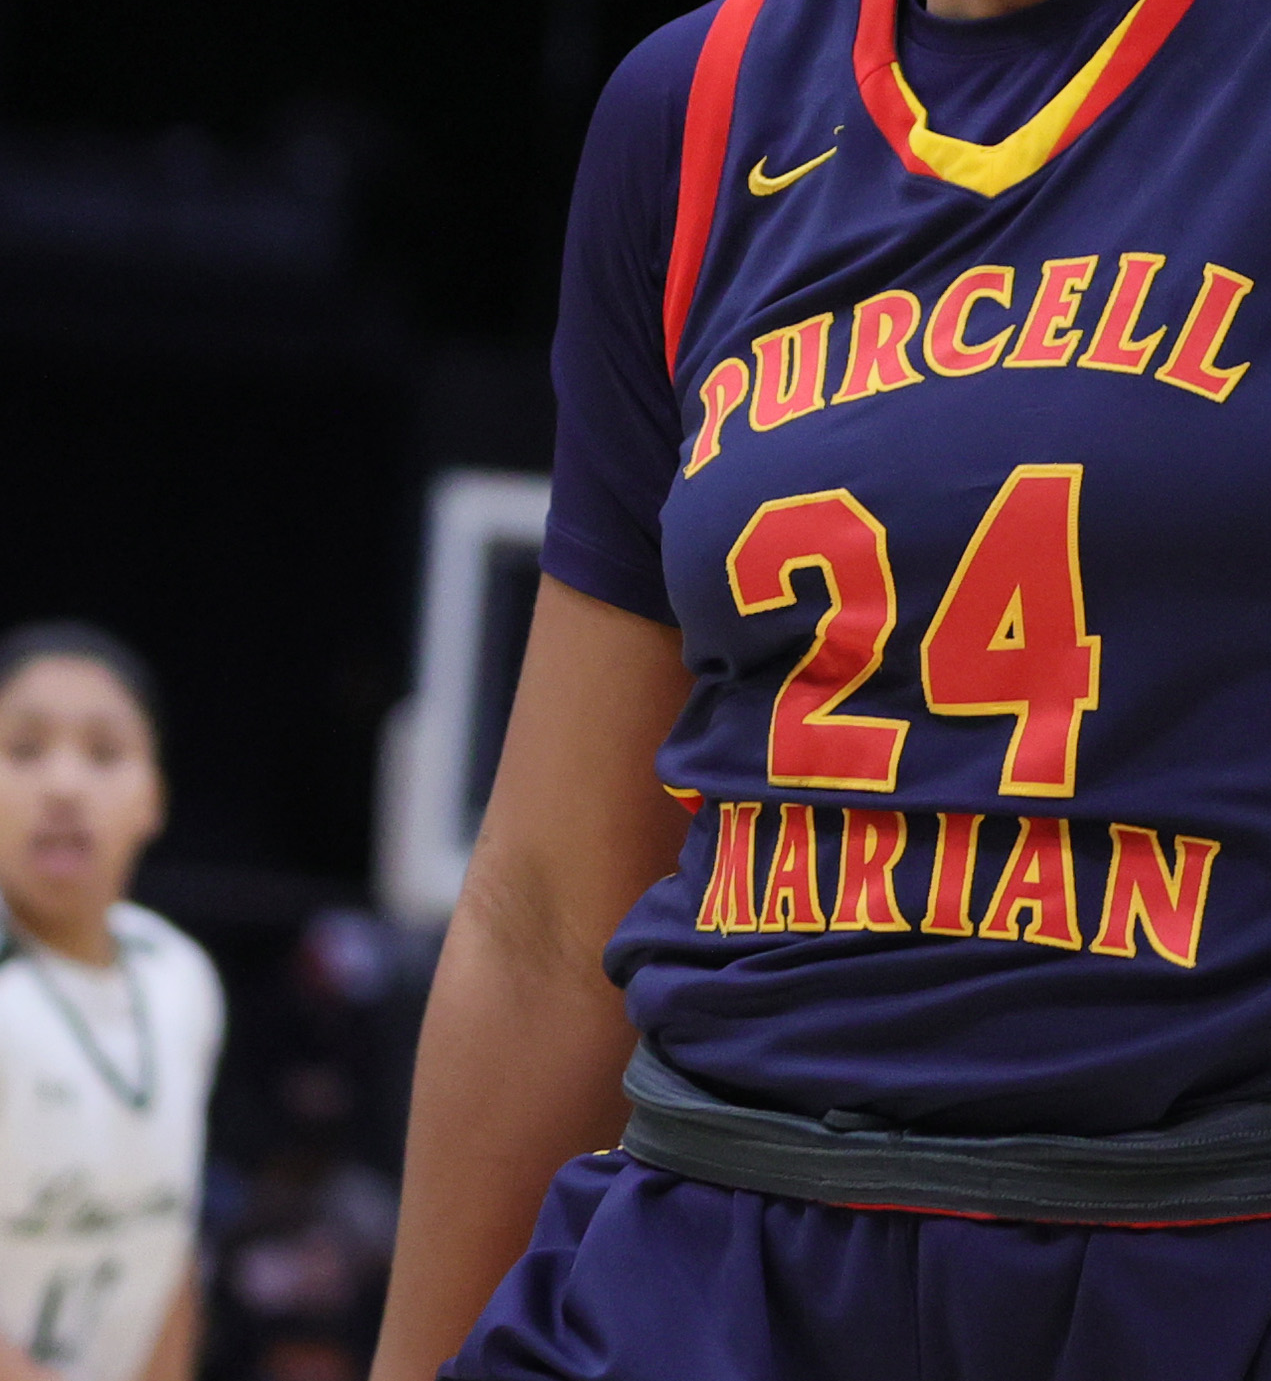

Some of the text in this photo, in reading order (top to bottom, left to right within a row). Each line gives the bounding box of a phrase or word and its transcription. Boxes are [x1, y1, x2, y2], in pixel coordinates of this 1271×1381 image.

[684, 252, 1254, 478] PURCELL
[726, 463, 1101, 798] 24
[695, 802, 1221, 969] MARIAN
